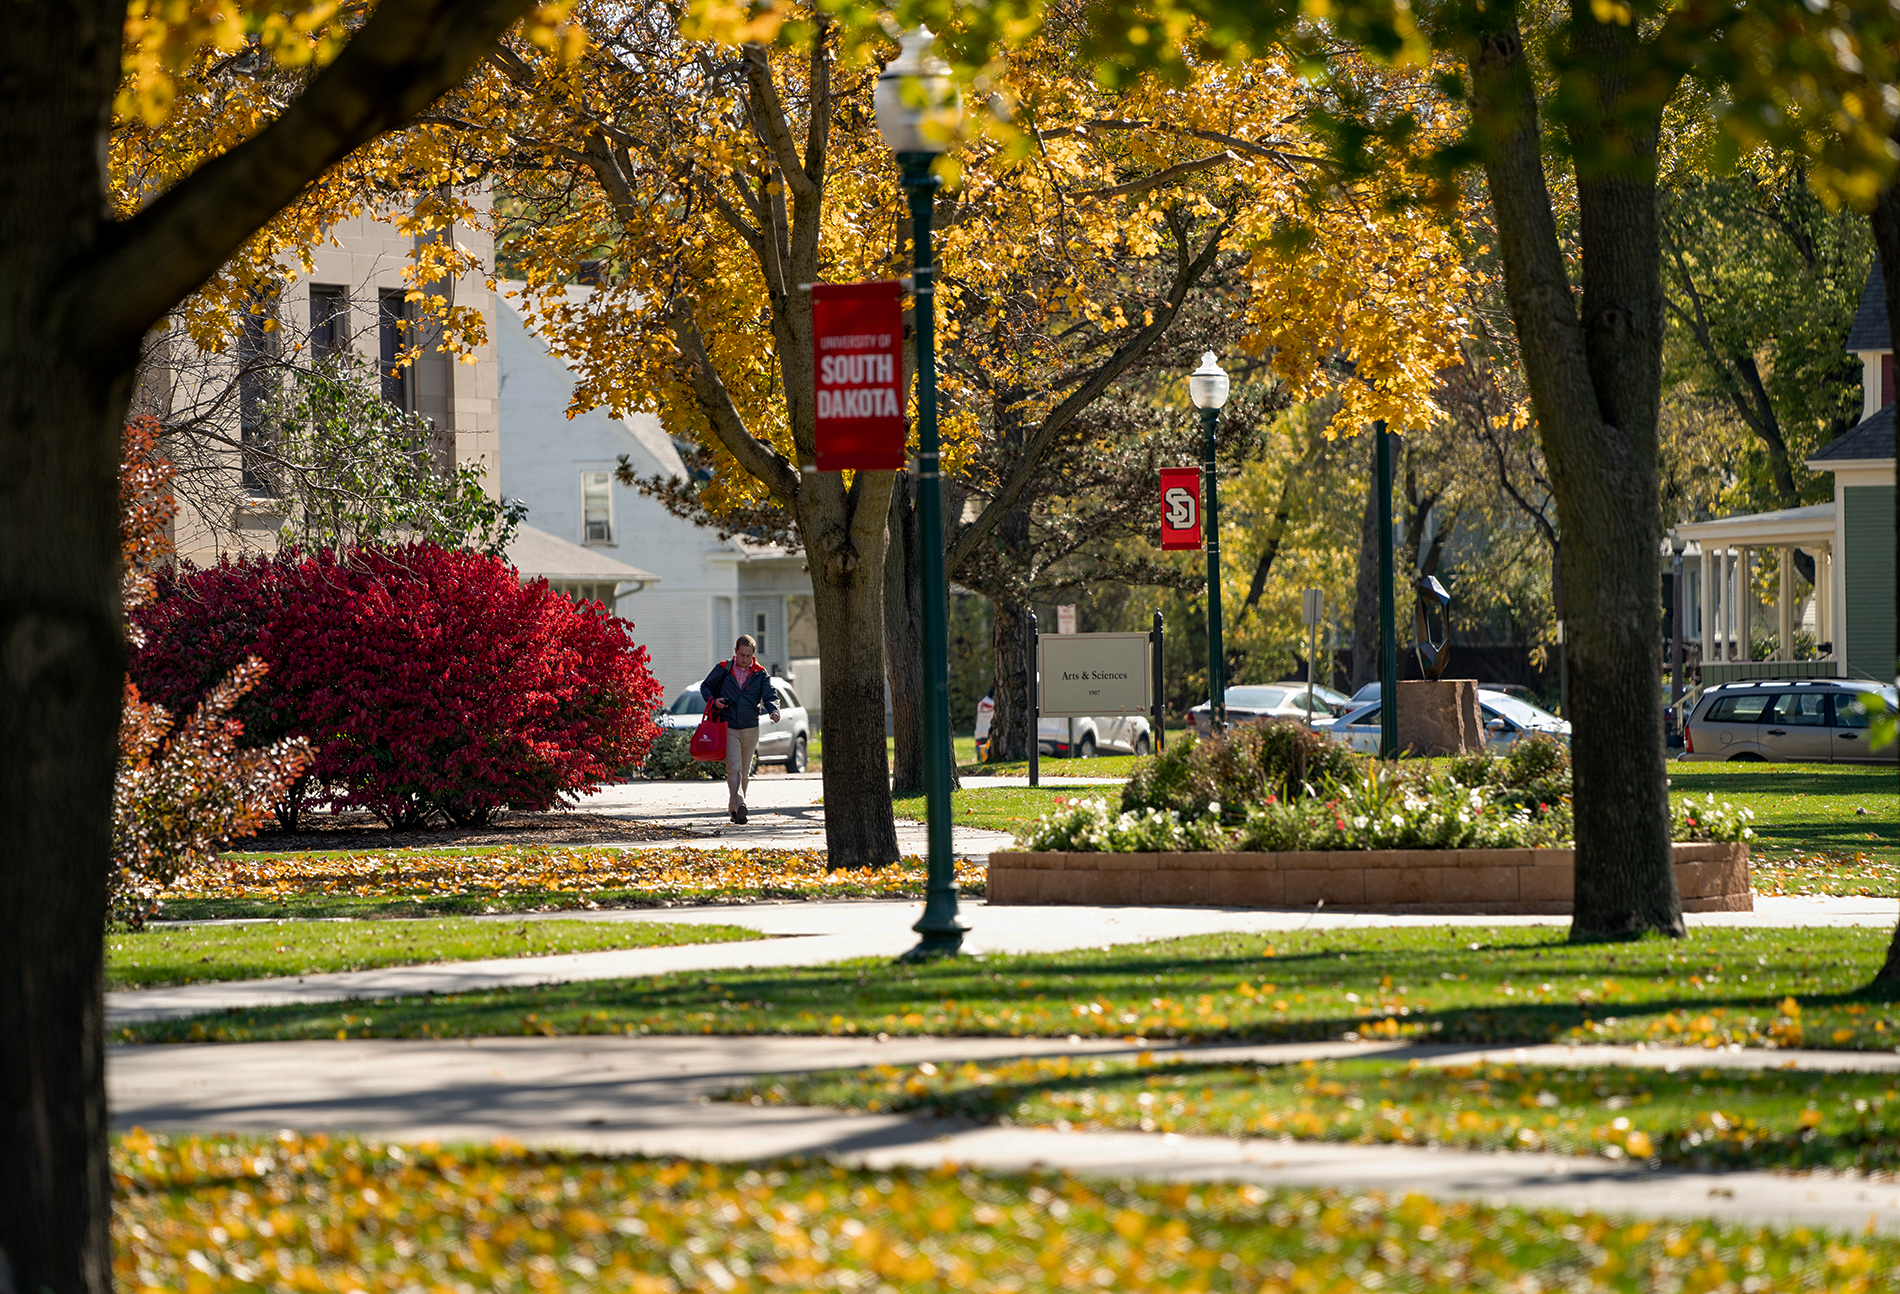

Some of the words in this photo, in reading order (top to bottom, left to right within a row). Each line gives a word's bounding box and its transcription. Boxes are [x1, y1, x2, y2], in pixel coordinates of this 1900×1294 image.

[820, 335, 877, 350] UNIVERSITY
[878, 334, 892, 348] OF
[820, 354, 893, 384] SOUTH
[817, 388, 899, 419] DAKOTA
[1062, 671, 1079, 680] Arts
[1081, 670, 1089, 680] &
[1091, 670, 1128, 680] Sciences
